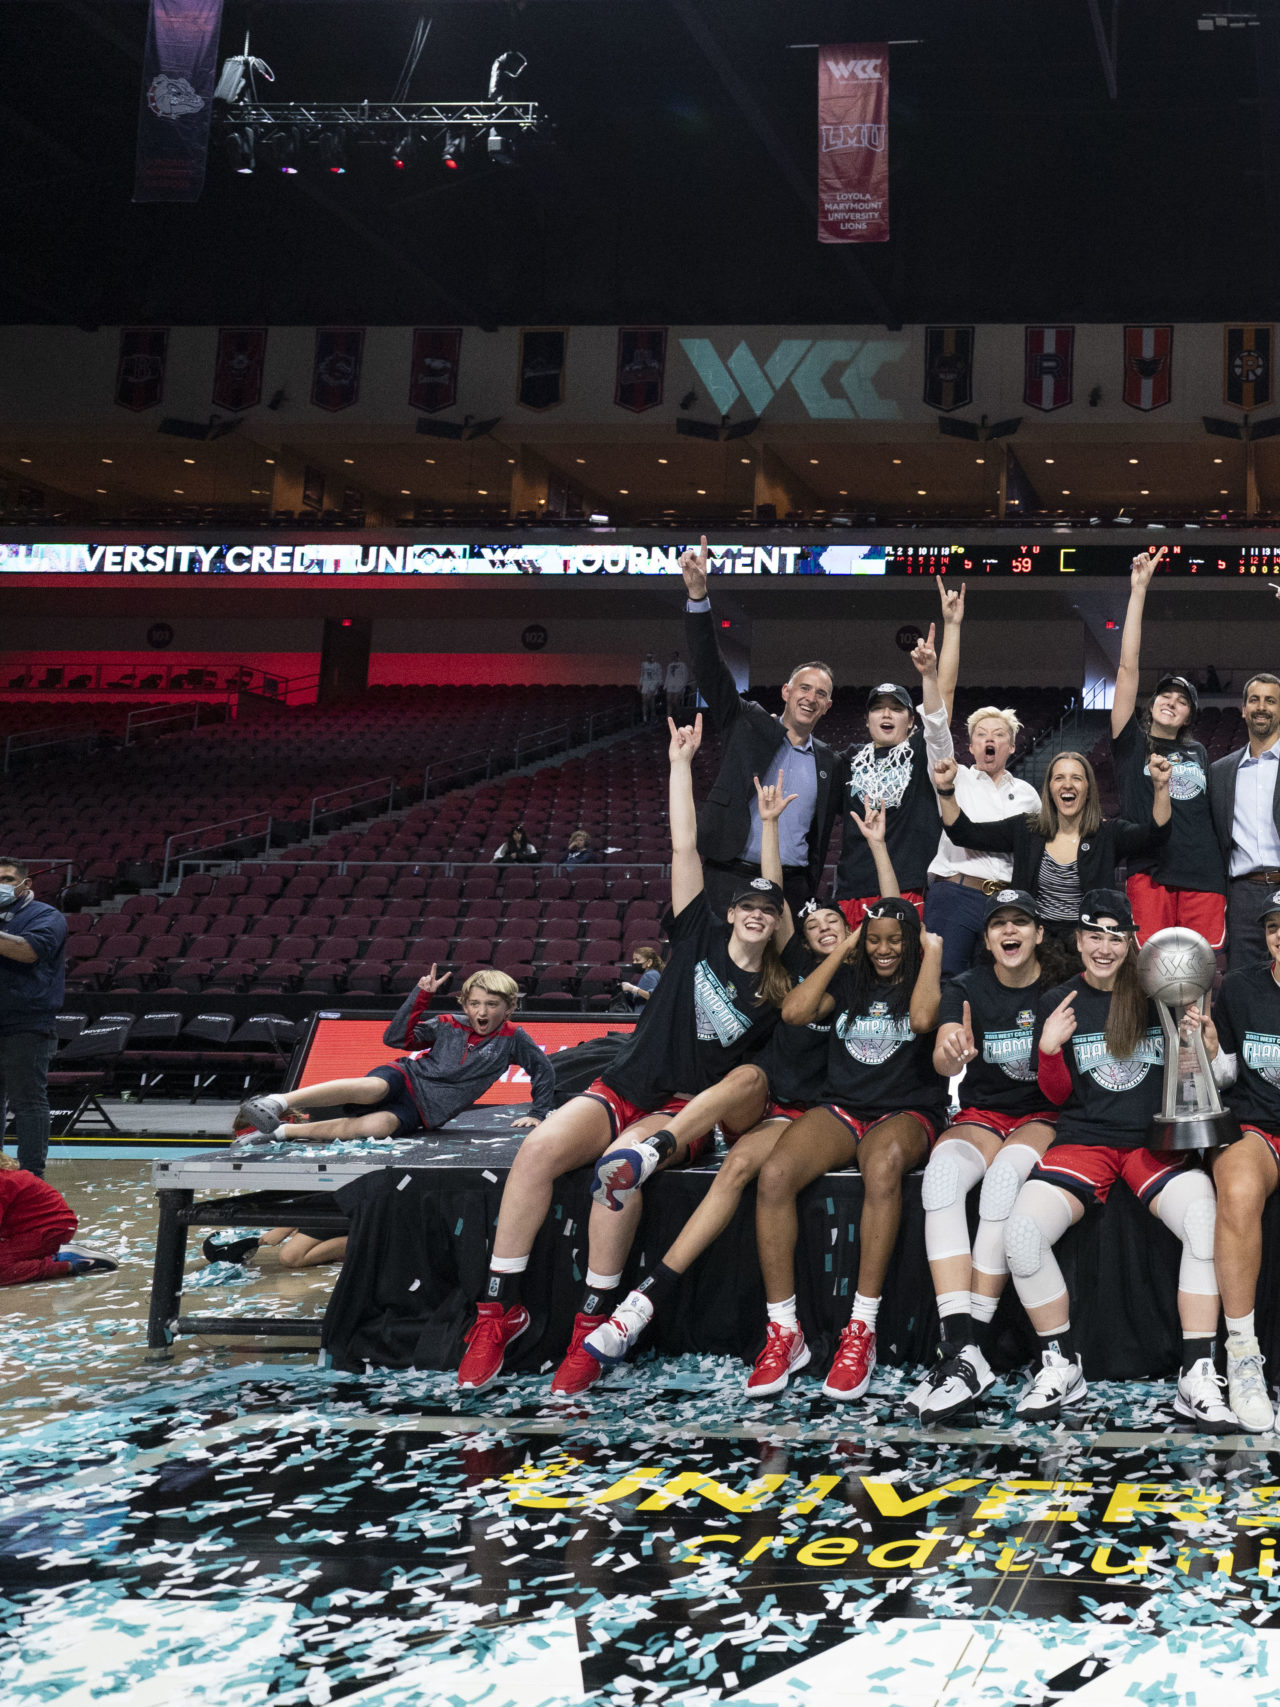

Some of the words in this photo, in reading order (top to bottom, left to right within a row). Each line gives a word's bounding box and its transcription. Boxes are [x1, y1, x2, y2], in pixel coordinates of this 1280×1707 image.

[826, 58, 882, 79] WCC
[821, 123, 885, 152] LMU
[836, 193, 871, 201] LOYOLA
[824, 201, 883, 211] MARYMOUNT
[828, 211, 880, 221] UNIVERSITY
[840, 222, 867, 230] LIONS
[678, 338, 906, 420] WCC
[1012, 557, 1032, 573] 59
[1260, 1035, 1276, 1044] WEST
[680, 1526, 1037, 1573] credit
